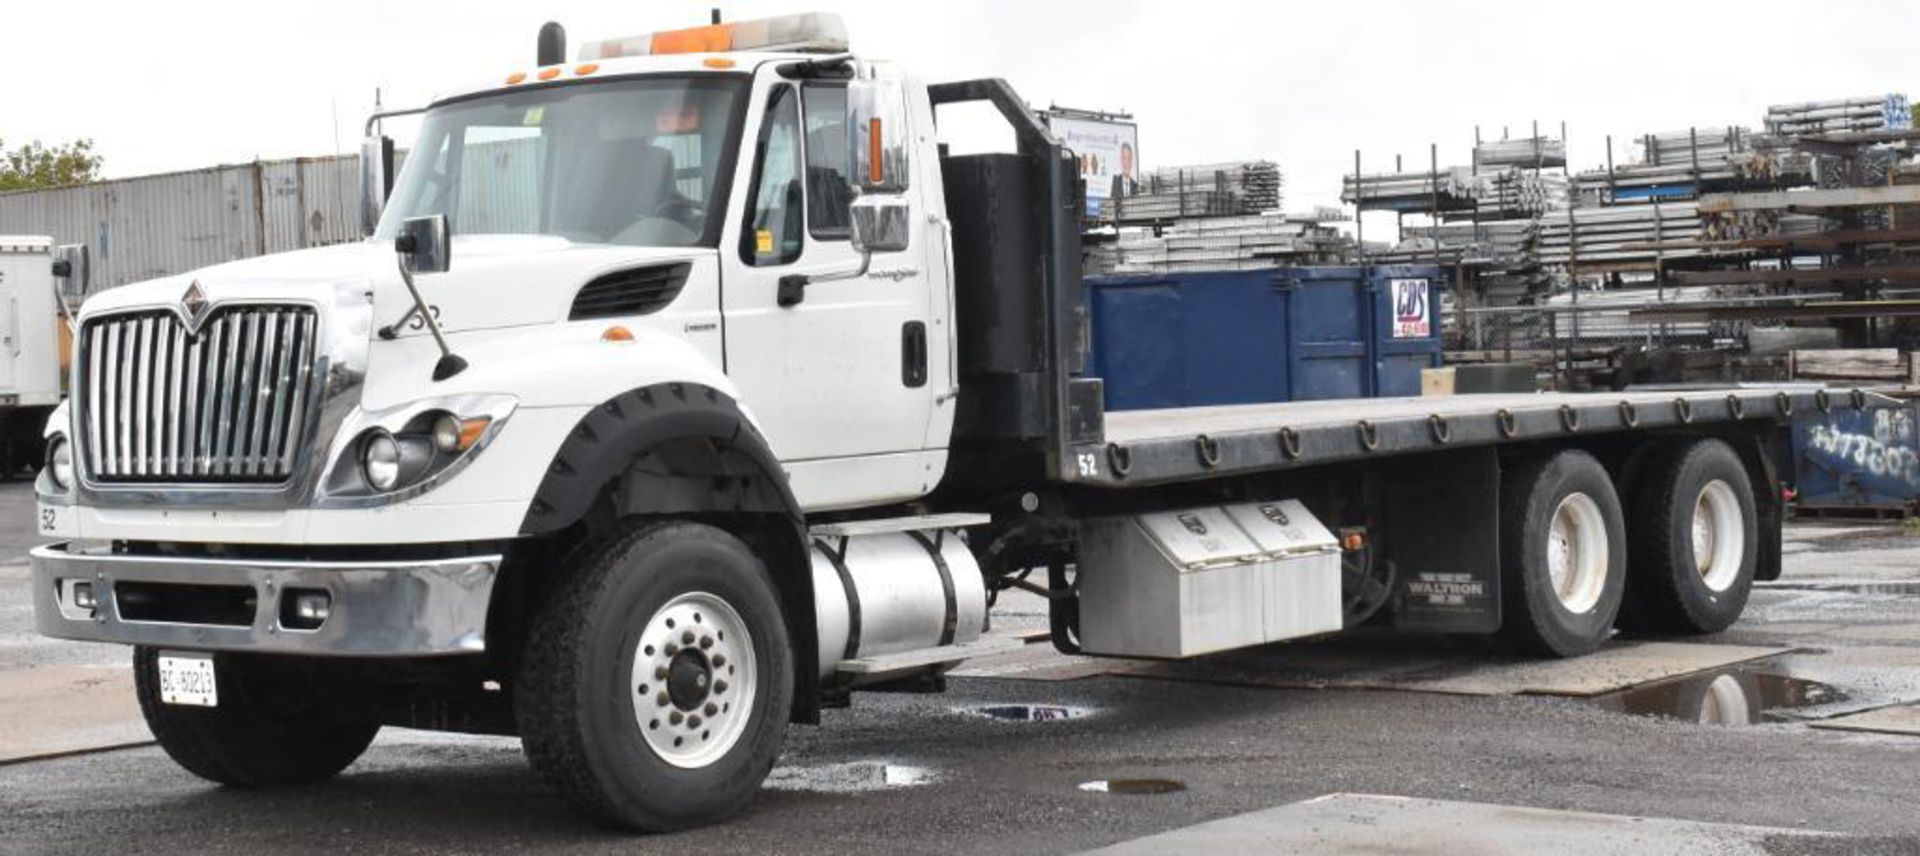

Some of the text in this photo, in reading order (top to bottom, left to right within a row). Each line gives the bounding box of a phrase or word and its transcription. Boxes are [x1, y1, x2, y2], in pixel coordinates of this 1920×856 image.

[1078, 453, 1098, 476] 52
[42, 508, 56, 531] 52
[1409, 582, 1483, 595] WALTRON
